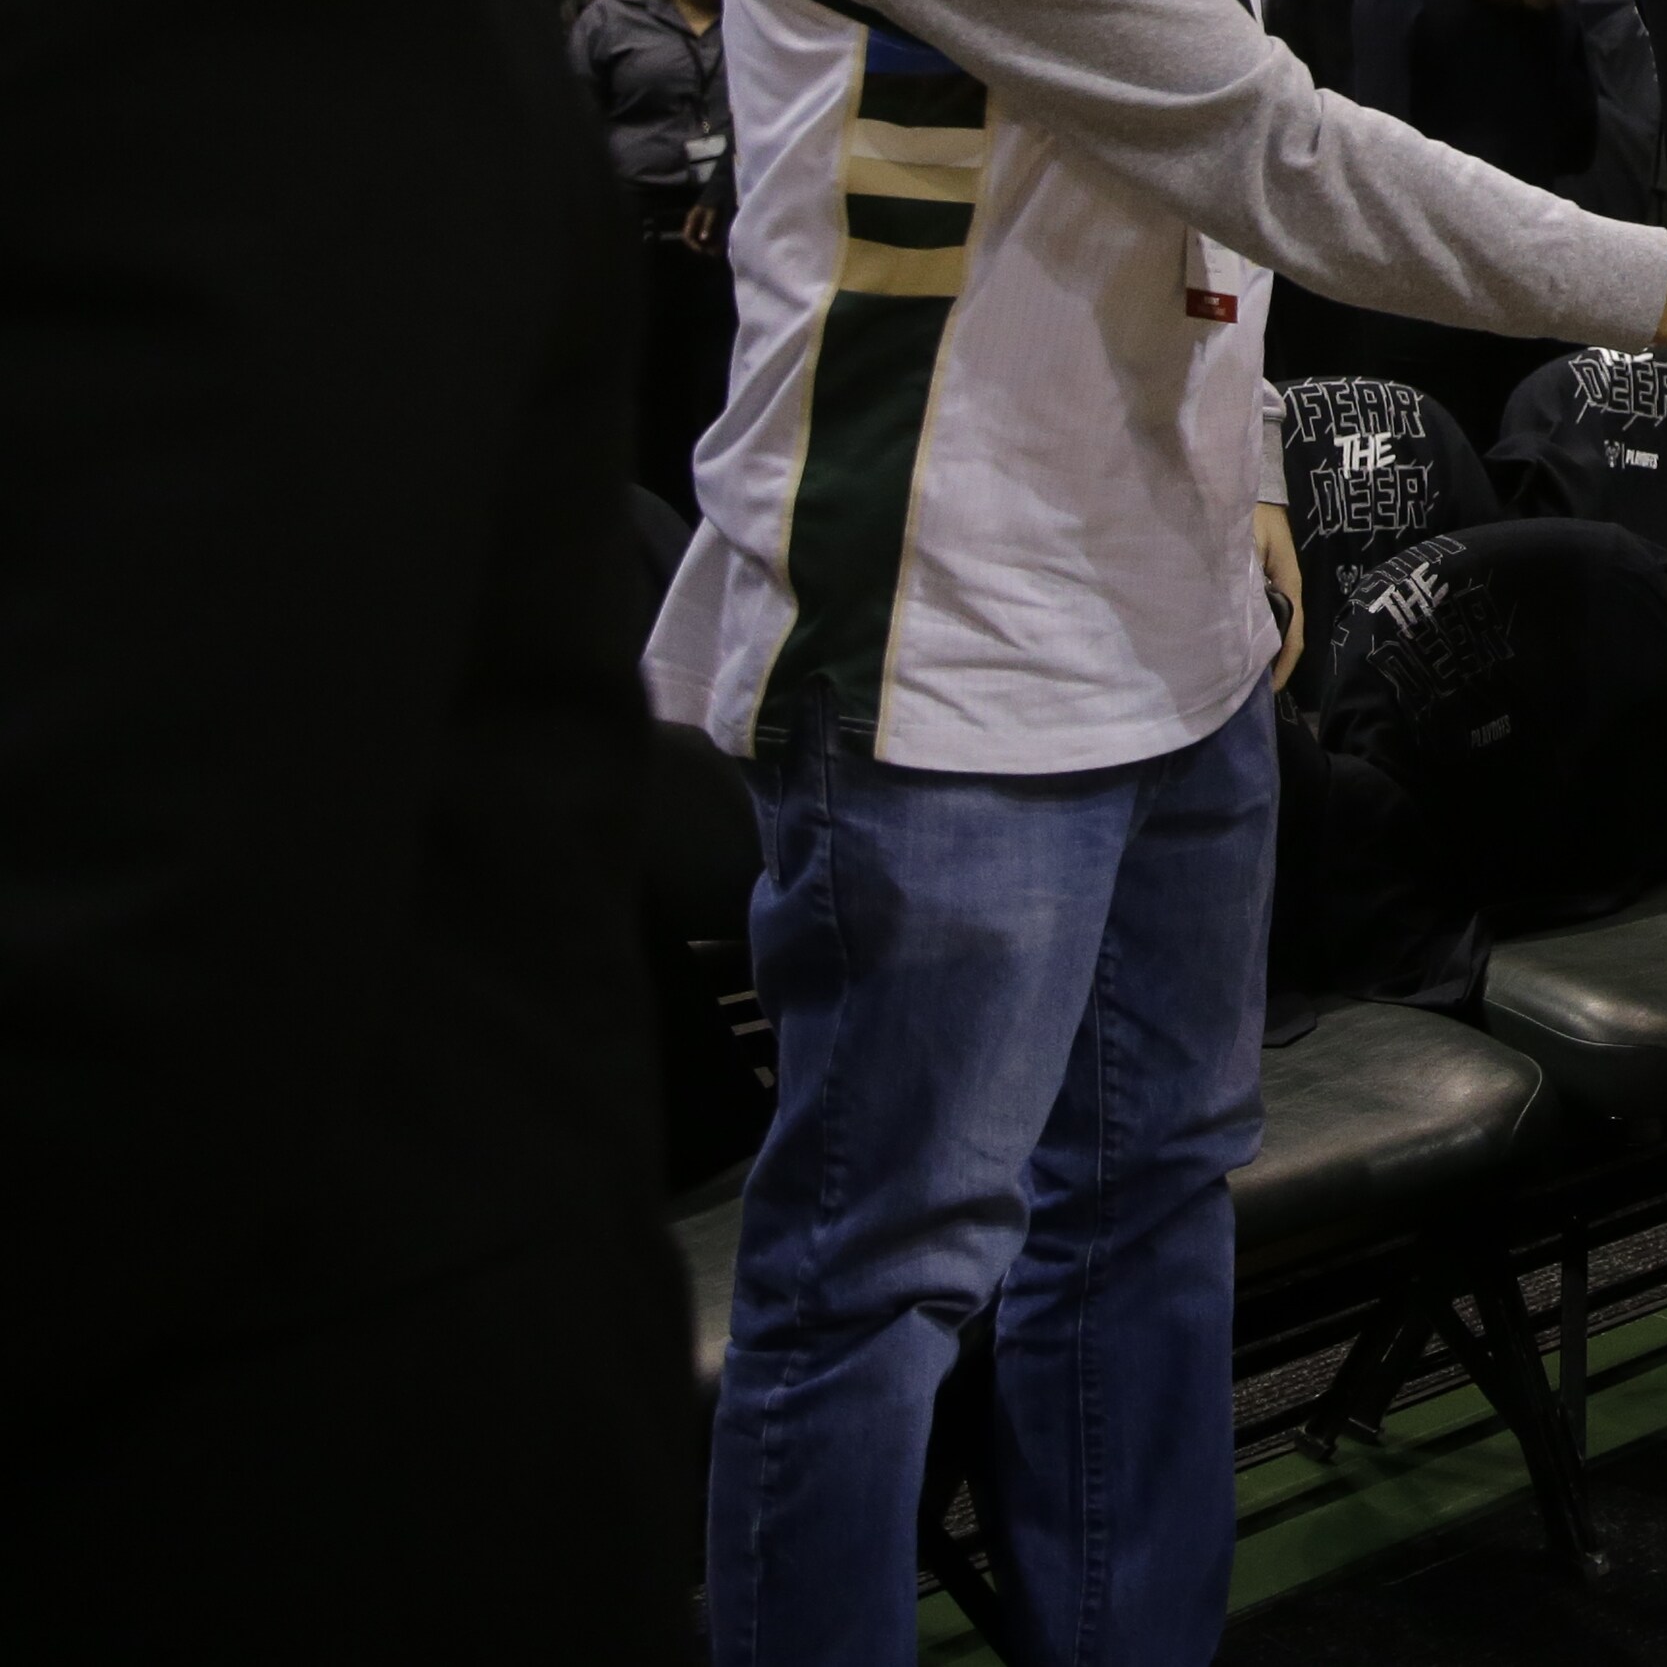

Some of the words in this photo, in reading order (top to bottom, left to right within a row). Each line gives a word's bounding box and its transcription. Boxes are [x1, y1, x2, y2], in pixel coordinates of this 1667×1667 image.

[1285, 379, 1427, 444] FEAR
[1333, 431, 1397, 480] THE
[1309, 463, 1430, 536] DEER
[1368, 561, 1450, 640] THE
[1470, 714, 1513, 749] PLAYOFFS
